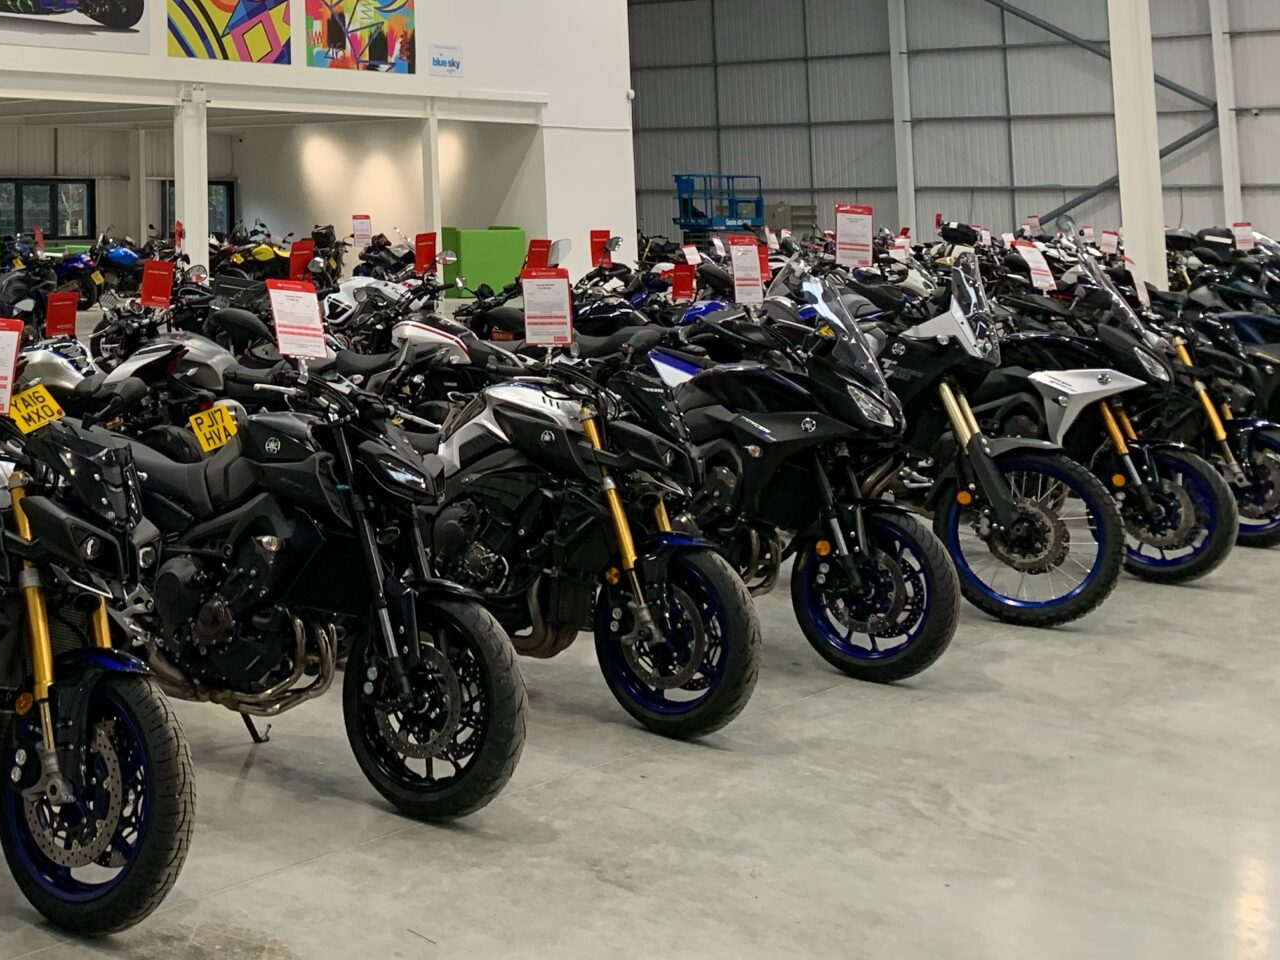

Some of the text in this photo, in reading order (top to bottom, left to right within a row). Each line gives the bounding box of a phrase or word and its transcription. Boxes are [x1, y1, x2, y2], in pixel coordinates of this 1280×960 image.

[432, 57, 461, 70] blue sky
[194, 408, 225, 432] PJ17
[204, 425, 233, 447] HVA
